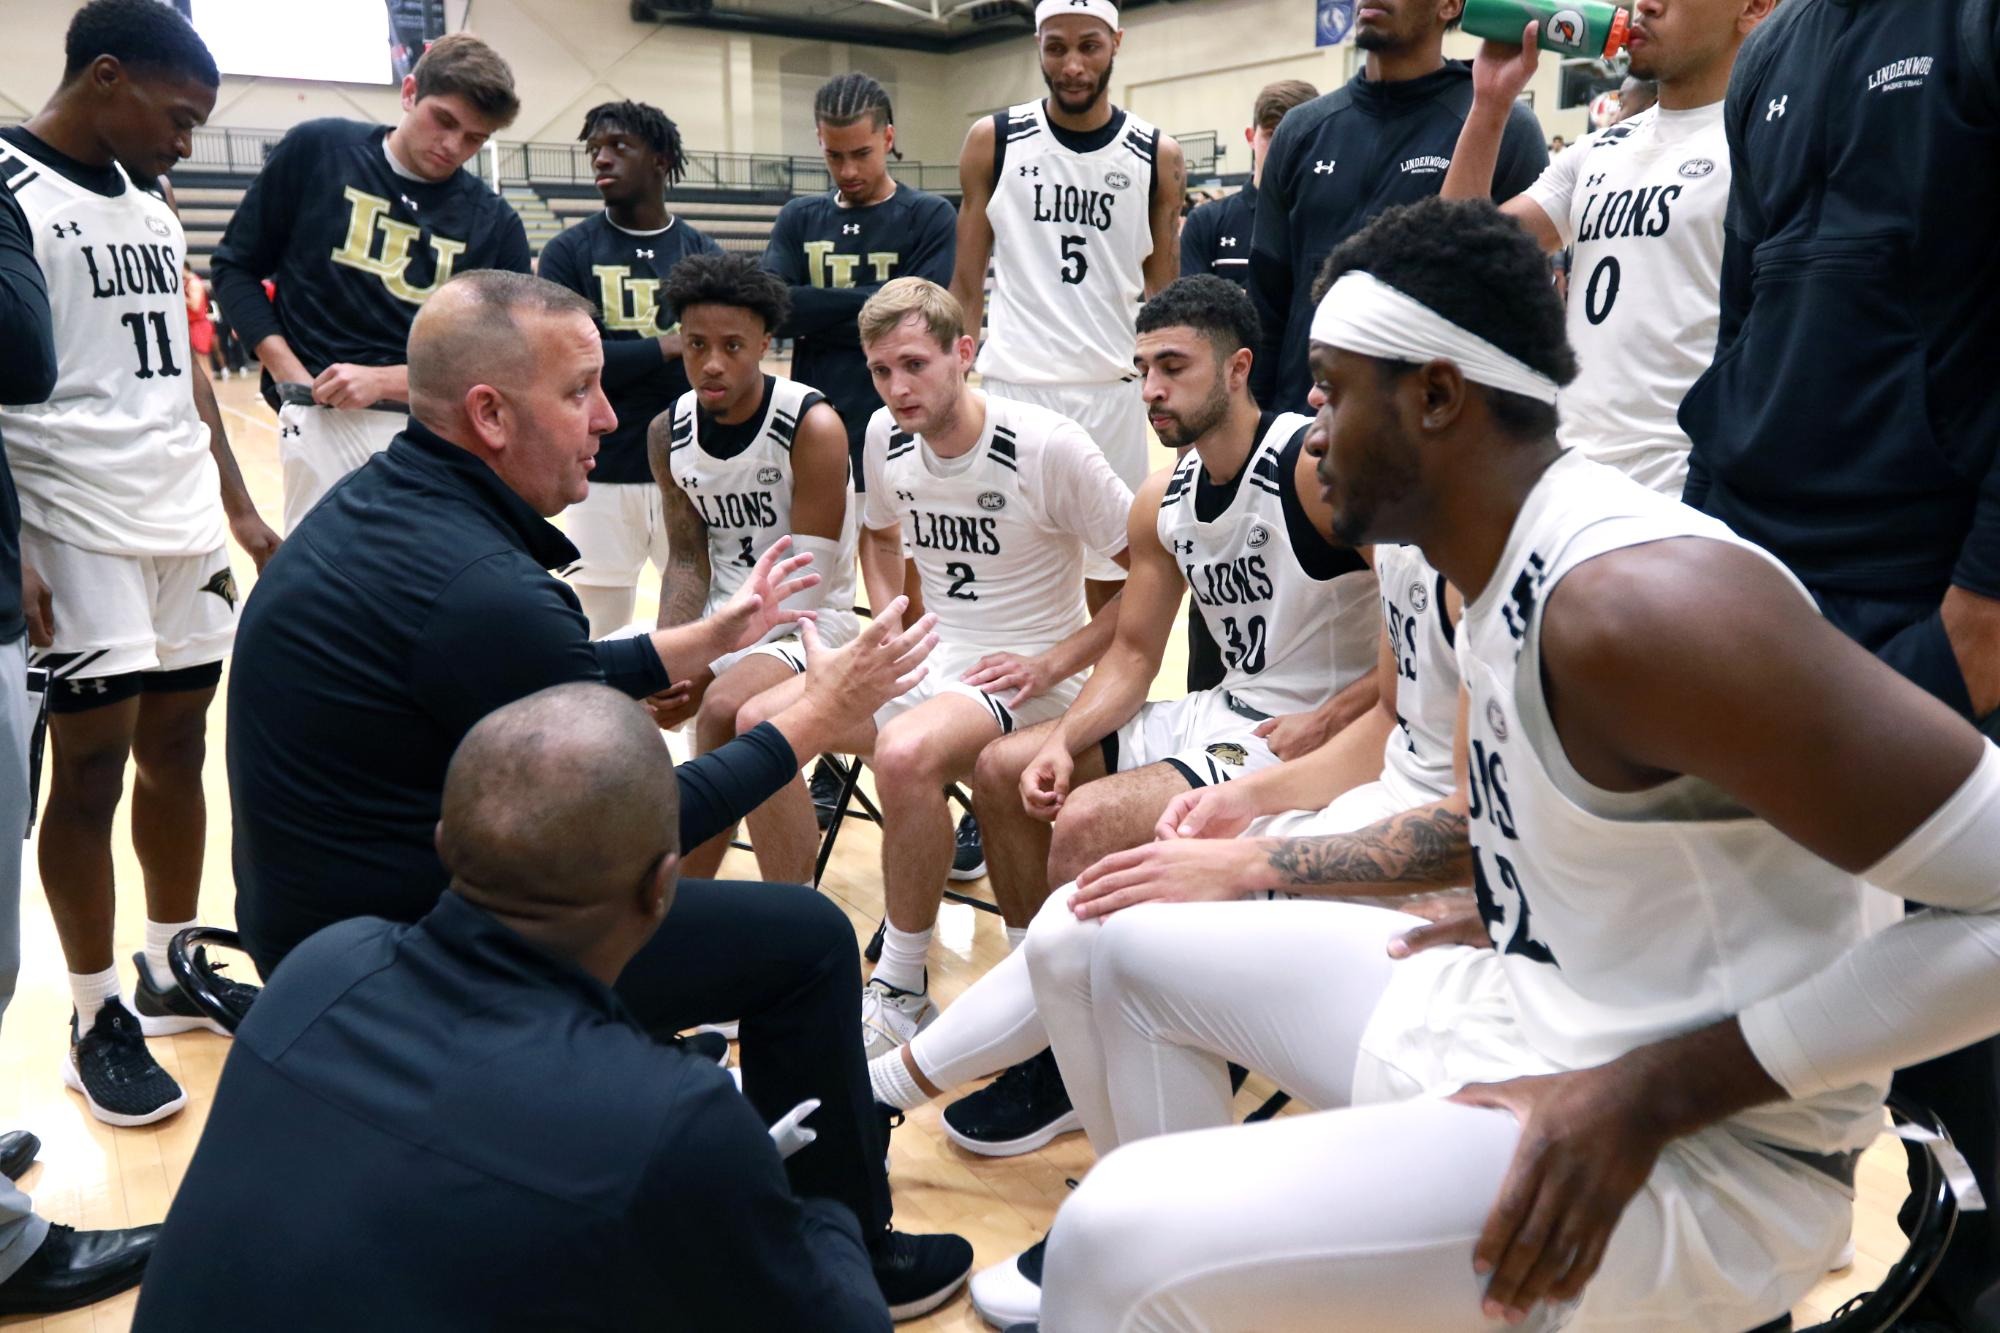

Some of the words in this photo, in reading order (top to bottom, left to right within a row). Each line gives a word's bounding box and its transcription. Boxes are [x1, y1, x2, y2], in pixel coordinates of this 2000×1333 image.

[1034, 184, 1115, 231] LIONS
[1578, 184, 1683, 242] LIONS
[331, 185, 466, 304] LU
[1061, 234, 1088, 285] 5
[81, 244, 178, 298] LIONS
[1585, 256, 1621, 326] 0
[121, 311, 182, 379] 11
[697, 491, 777, 528] LIONS
[910, 509, 1000, 555] LIONS
[946, 562, 978, 601] 2
[1186, 555, 1273, 606] LIONS
[1220, 615, 1266, 674] 30
